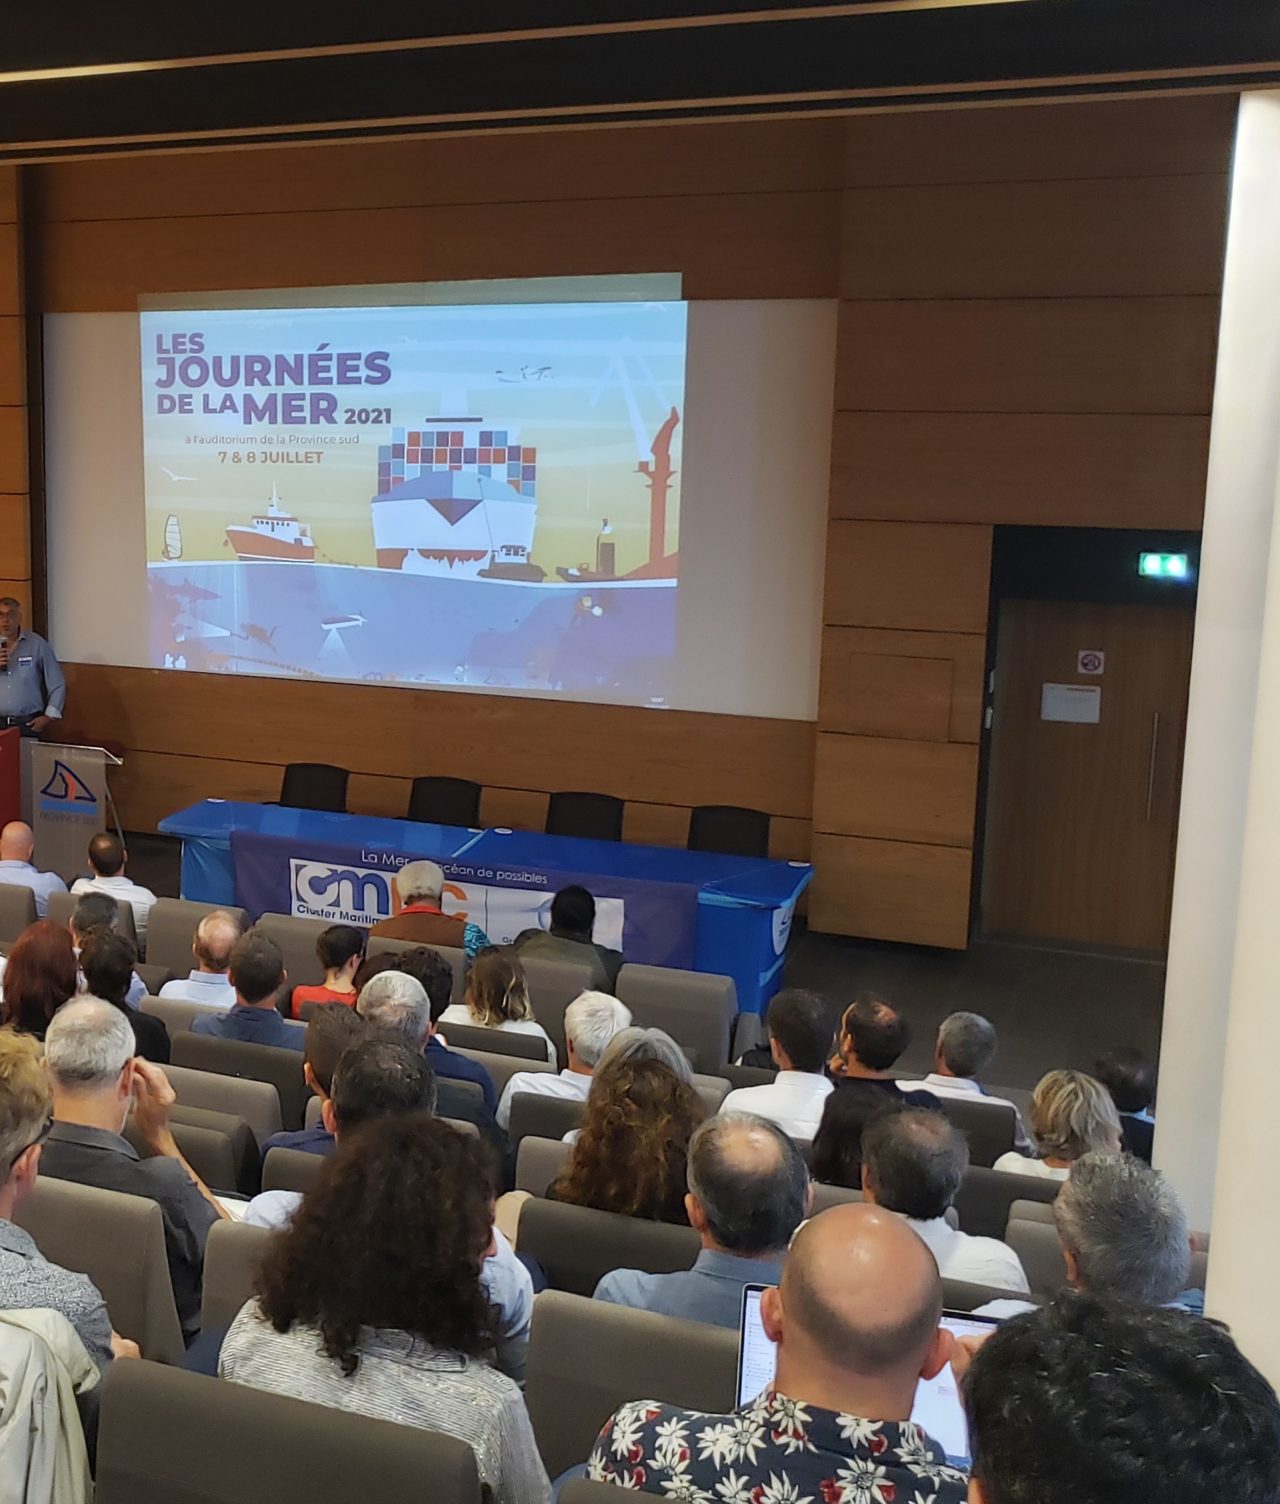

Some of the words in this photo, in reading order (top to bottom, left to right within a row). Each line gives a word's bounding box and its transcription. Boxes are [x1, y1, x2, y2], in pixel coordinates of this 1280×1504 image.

[156, 332, 205, 355] LES
[155, 342, 392, 389] JOURNÉES
[157, 393, 194, 415] DE
[202, 393, 239, 414] LA
[242, 392, 338, 425] MER
[344, 407, 392, 425] 2021
[185, 435, 191, 444] à
[193, 434, 258, 444] l'auditorium
[260, 434, 274, 444] de
[276, 434, 286, 444] la
[288, 435, 336, 445] Province
[338, 434, 360, 444] sud
[218, 451, 227, 463] 7
[231, 451, 242, 464] &
[246, 451, 256, 464] 8
[260, 451, 324, 464] JUILLET
[361, 850, 378, 863] La
[477, 867, 493, 878] de
[496, 871, 548, 884] possibles
[297, 904, 336, 919] Cluster
